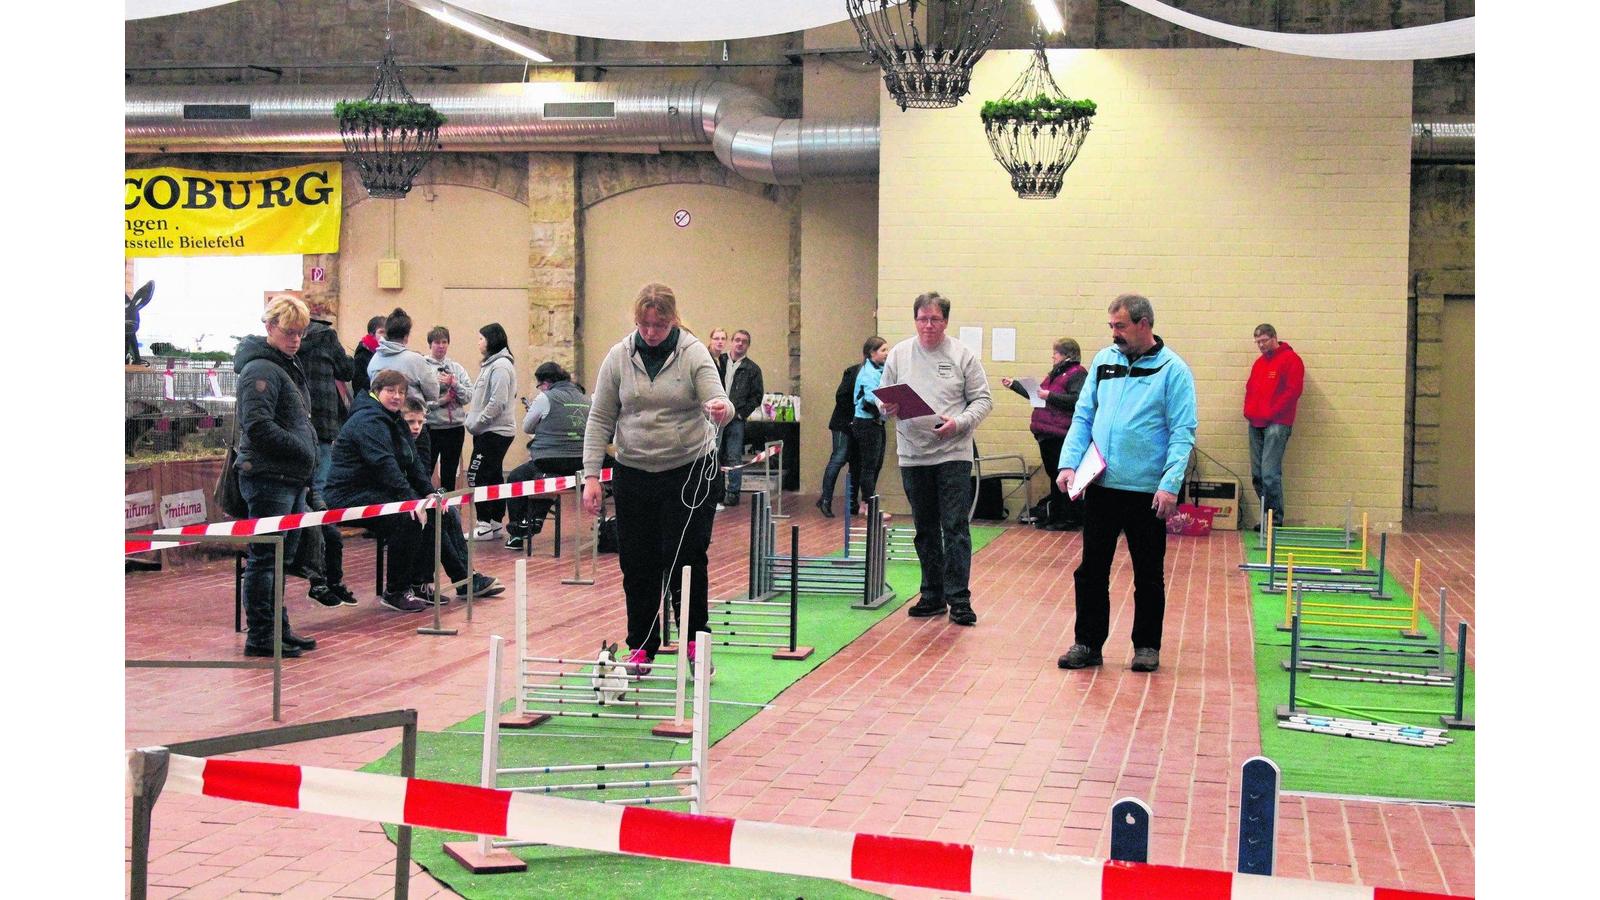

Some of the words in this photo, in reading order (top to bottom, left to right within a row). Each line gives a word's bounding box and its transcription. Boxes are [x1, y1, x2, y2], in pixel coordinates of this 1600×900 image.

[125, 171, 334, 210] COBURG
[125, 236, 174, 248] tsstelle
[179, 236, 245, 249] Bielefeld
[168, 503, 202, 518] mifuma
